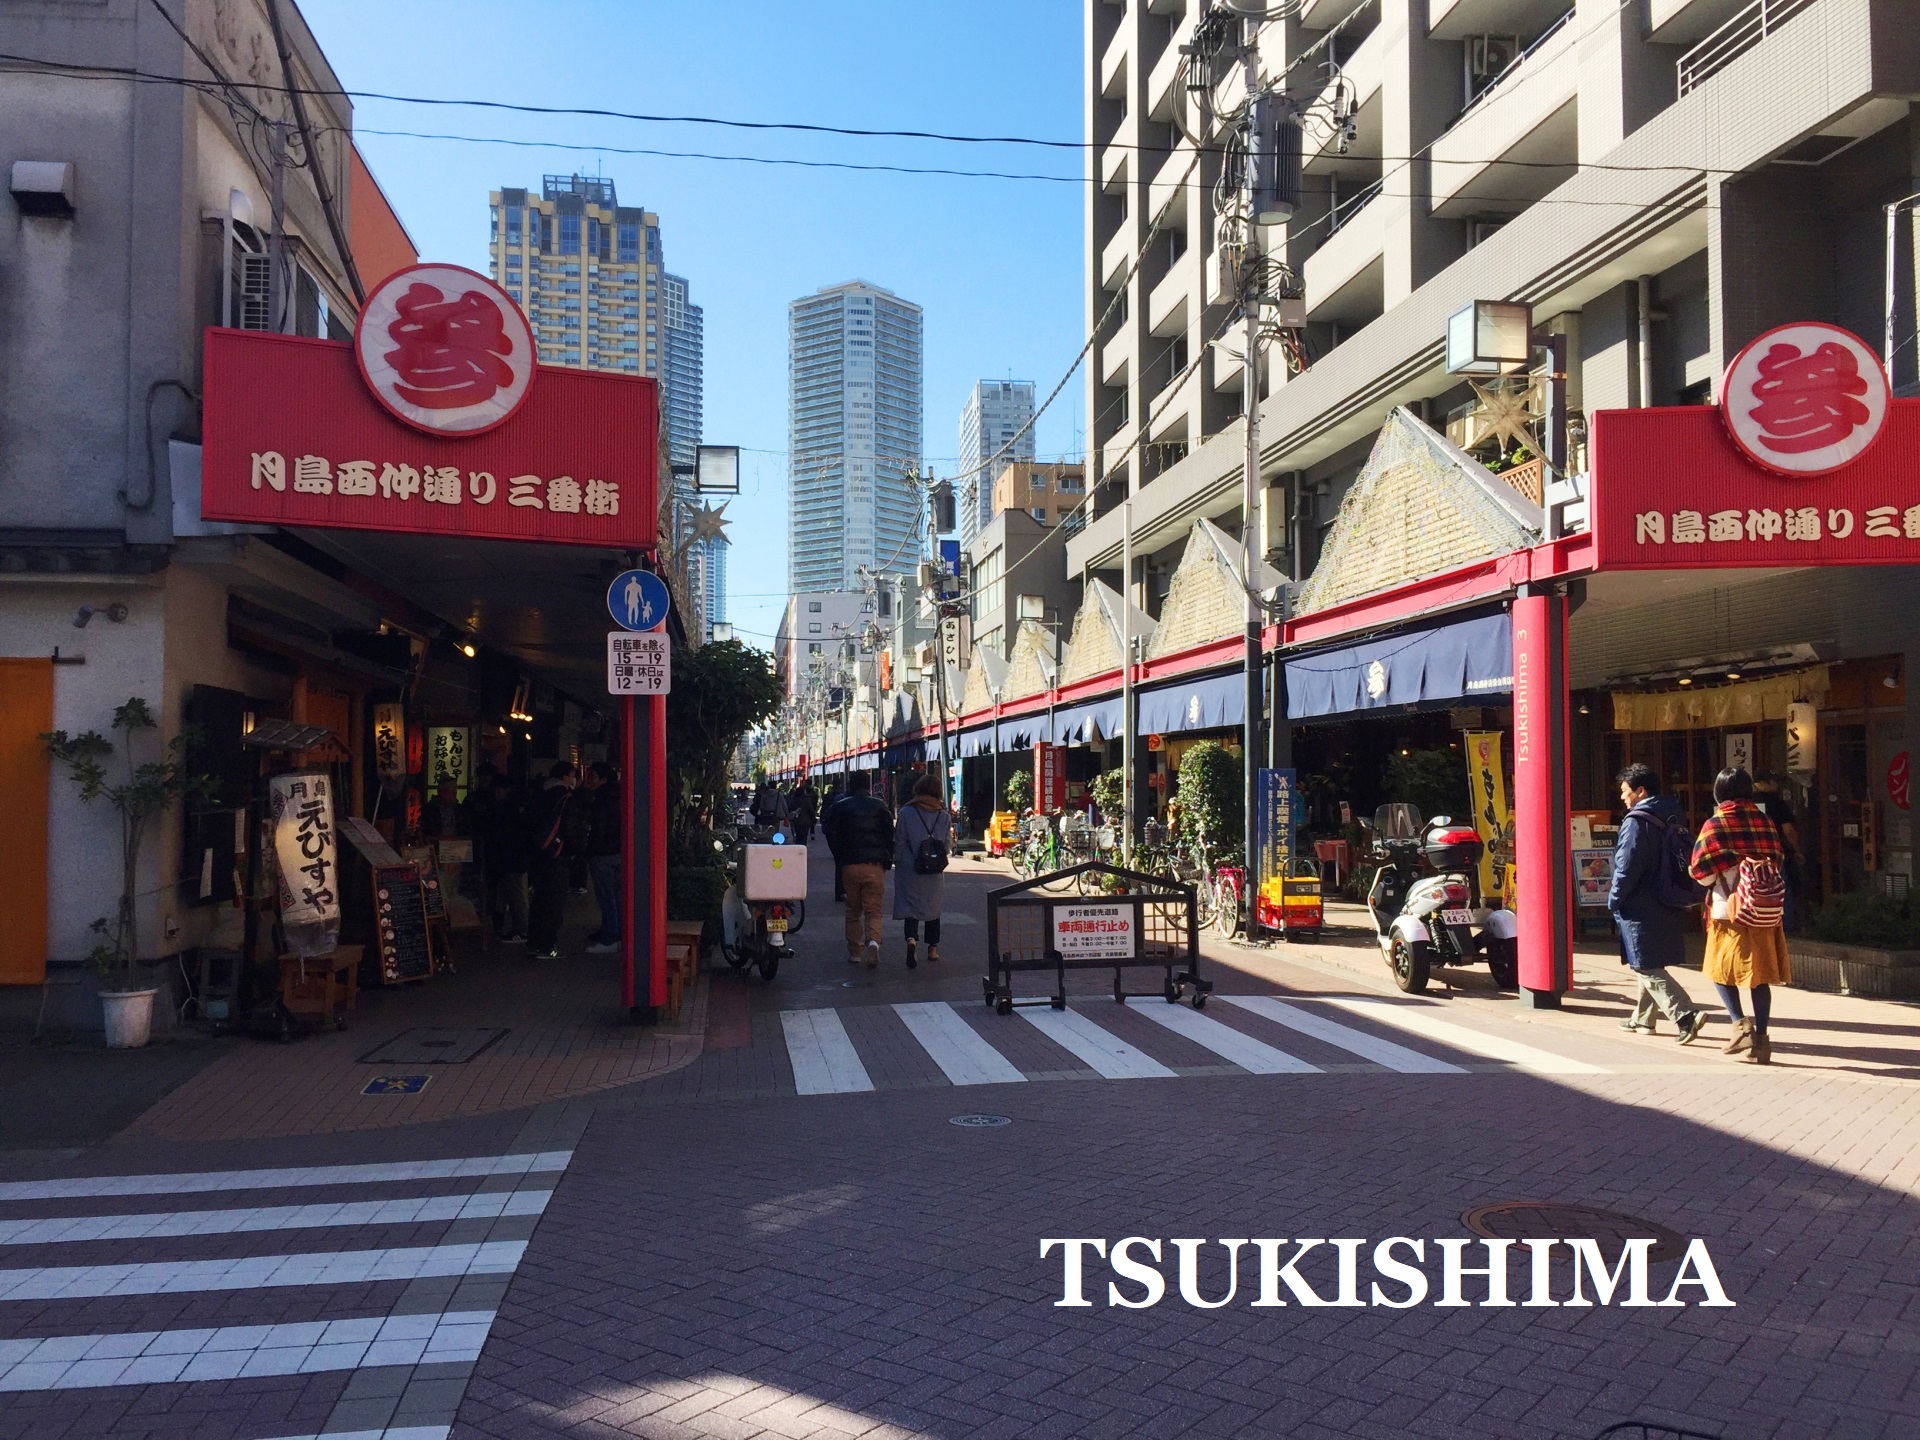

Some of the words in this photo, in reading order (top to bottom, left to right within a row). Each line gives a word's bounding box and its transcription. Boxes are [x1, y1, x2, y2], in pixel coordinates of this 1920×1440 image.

[250, 450, 620, 517] 月島西仲通り三番街
[1517, 628, 1529, 641] 3
[613, 639, 665, 651] 自転車を除く
[615, 666, 664, 677] 日曜・休日は
[880, 652, 889, 689] SLOT
[1517, 652, 1529, 767] Tsukishima
[295, 799, 334, 915] えびすや
[1058, 919, 1130, 933] 車両通行止め
[1446, 914, 1473, 924] 44-21
